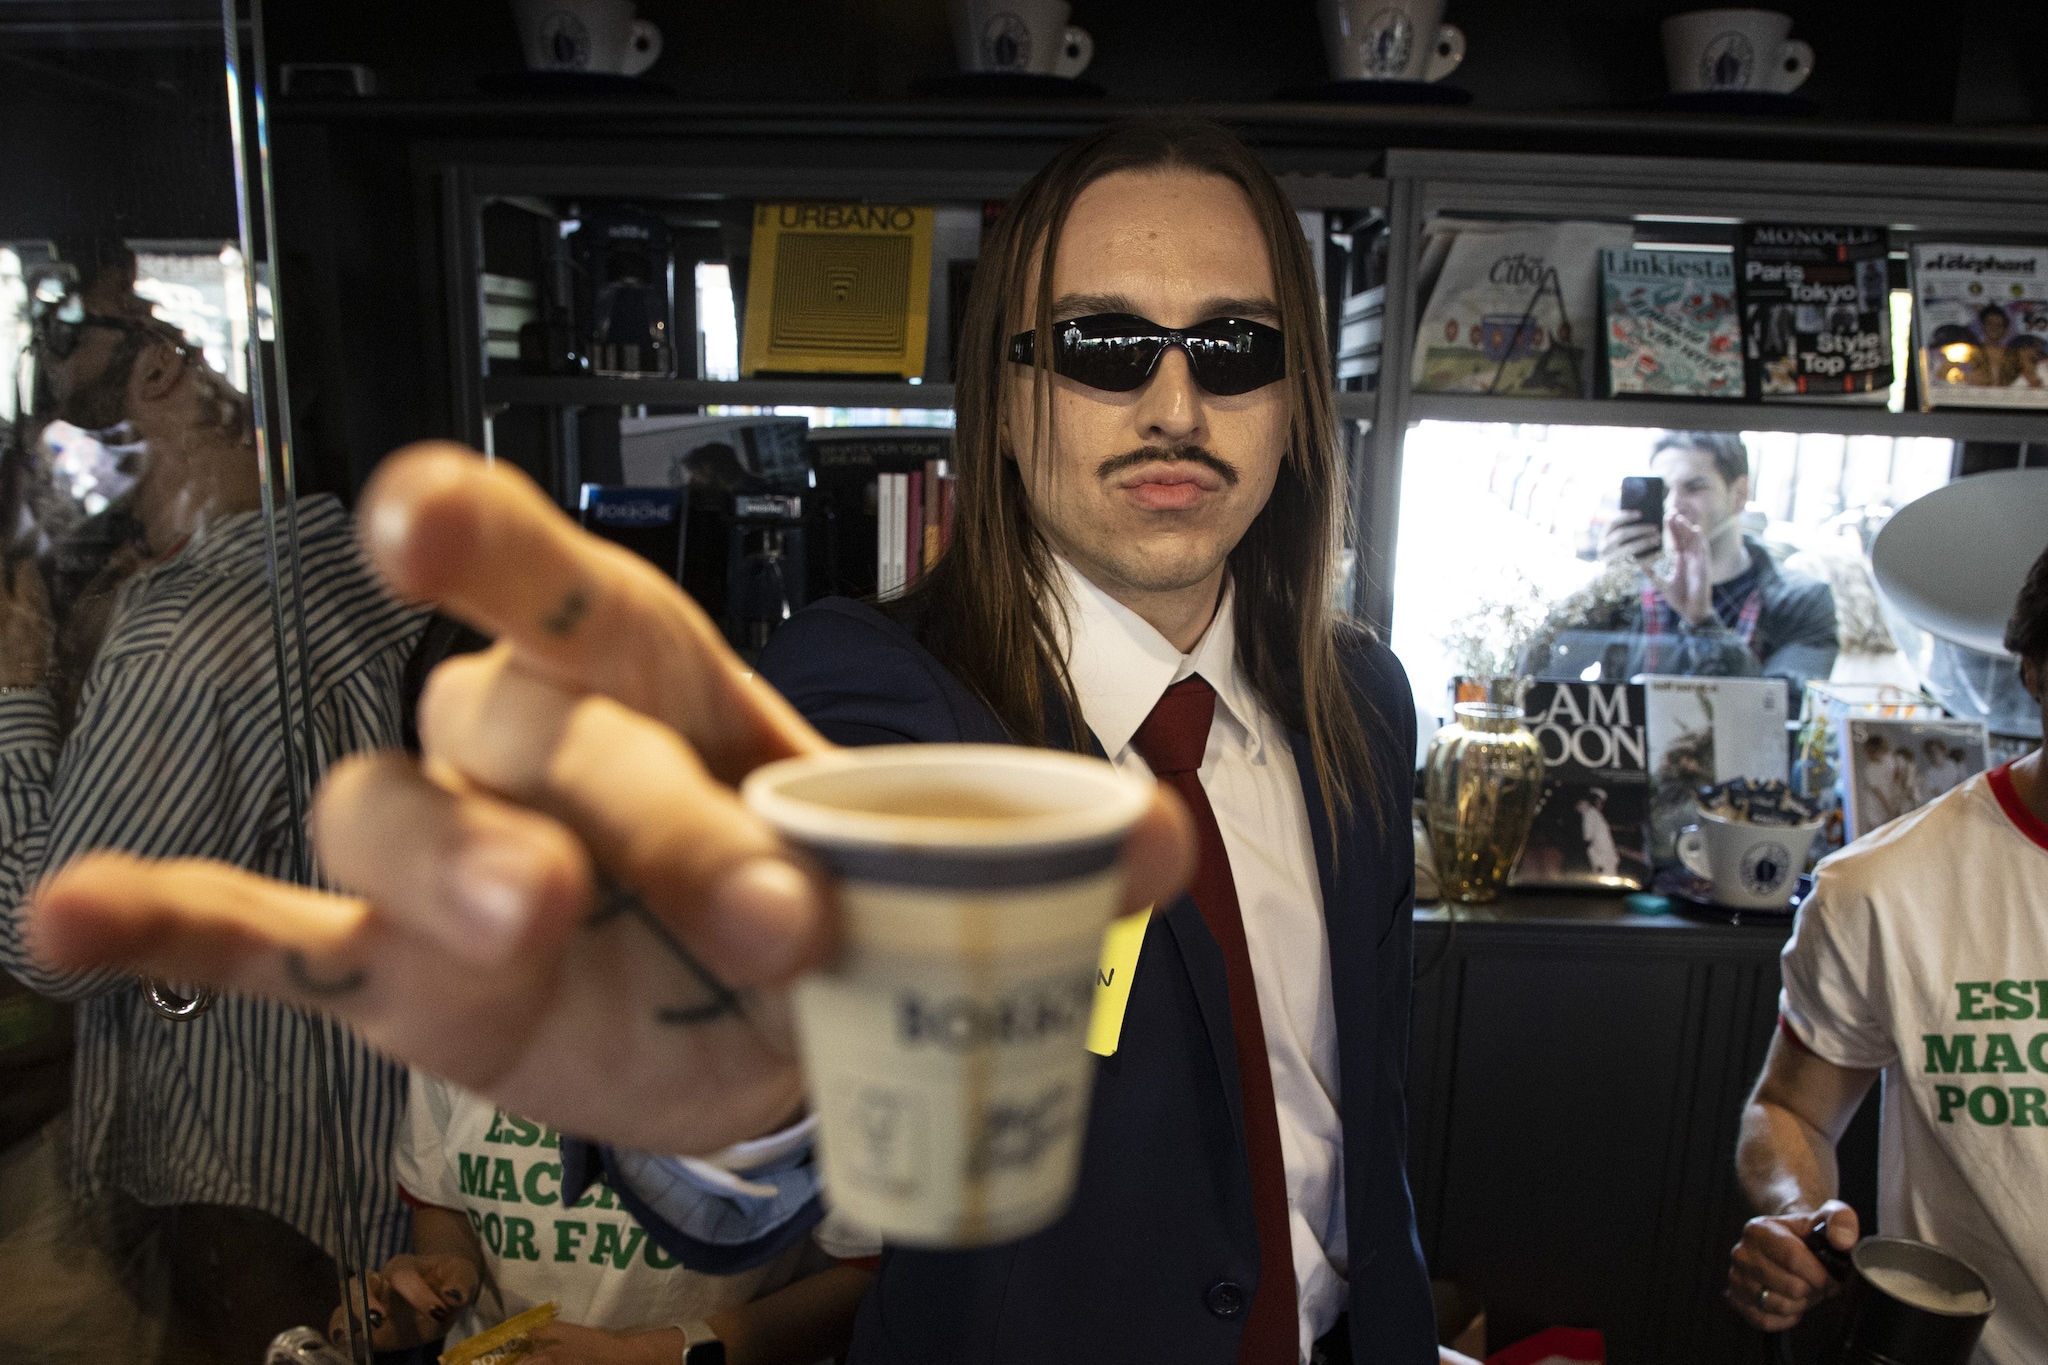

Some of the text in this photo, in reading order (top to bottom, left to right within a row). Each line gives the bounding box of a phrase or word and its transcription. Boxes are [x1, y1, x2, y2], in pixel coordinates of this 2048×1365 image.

[779, 204, 915, 231] URBANO
[1753, 226, 1878, 245] MONOCLE
[1607, 252, 1731, 278] Linkiesta
[1745, 261, 1805, 283] Paris
[1787, 281, 1857, 305] Tokyo
[1817, 330, 1880, 357] Style
[1800, 350, 1882, 376] Top 25
[1934, 1085, 2048, 1126] POR
